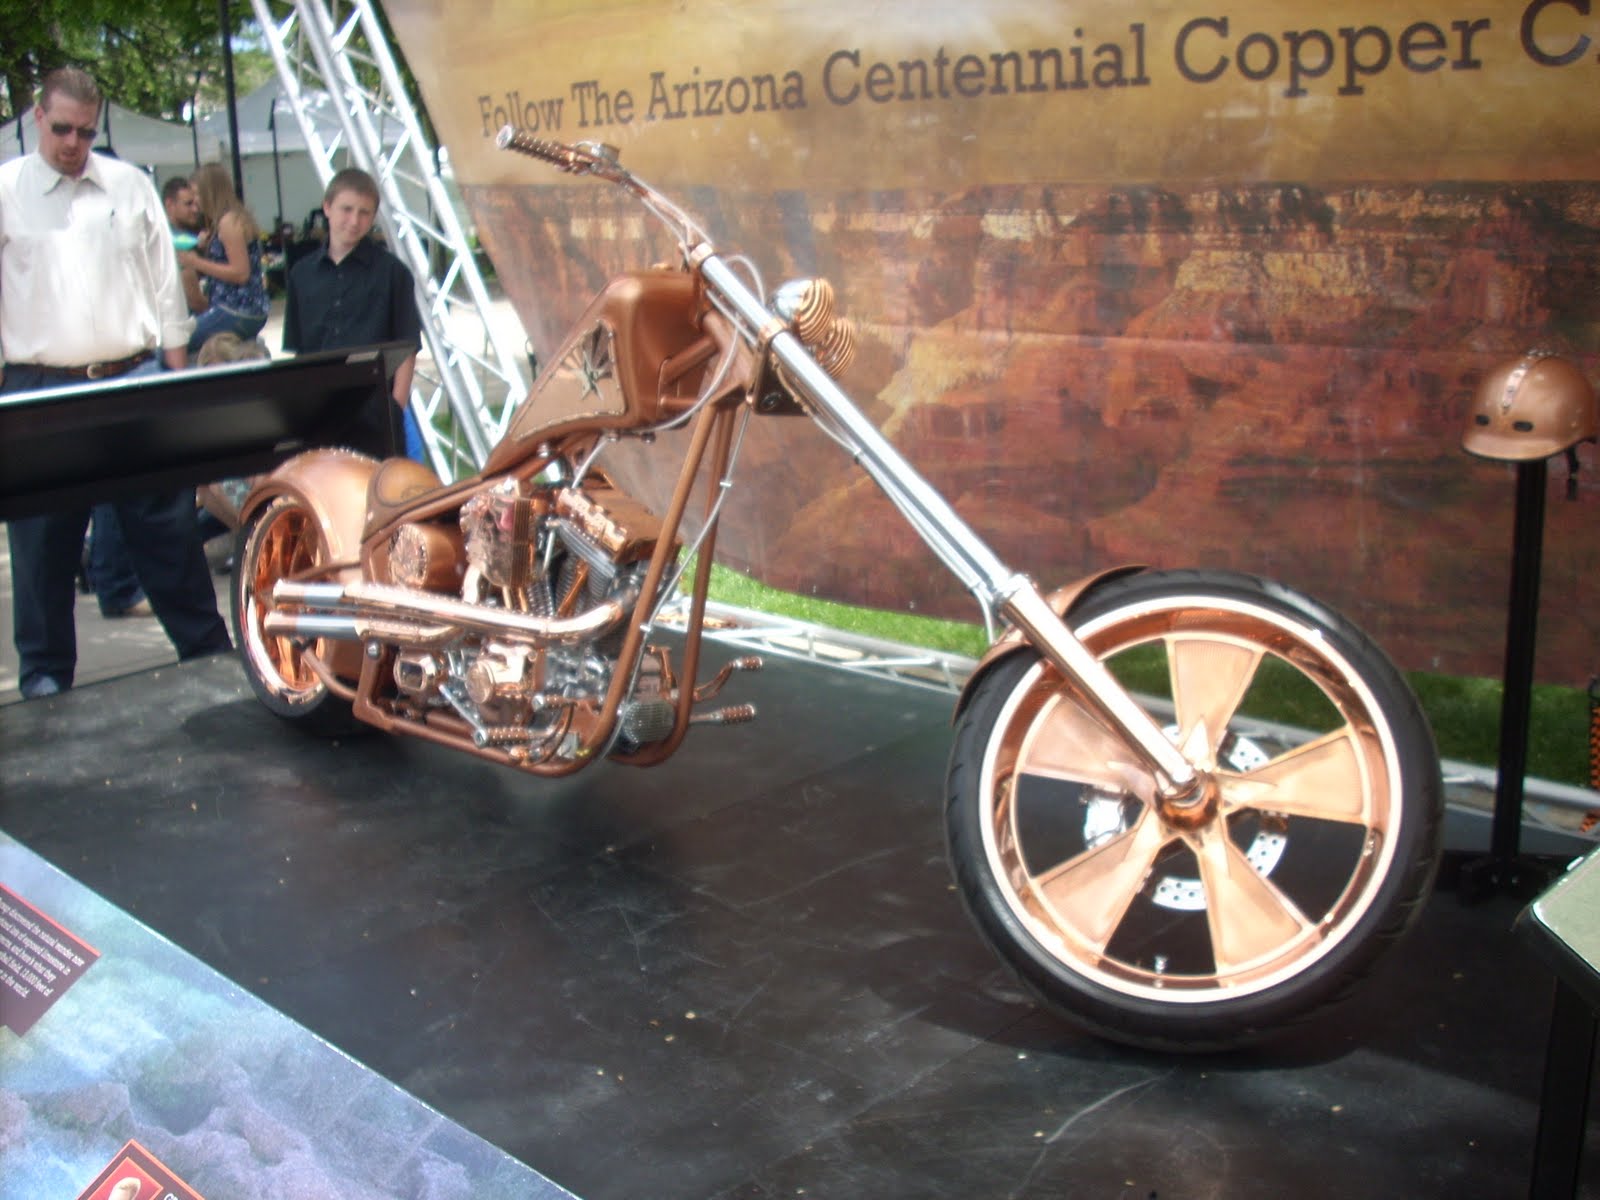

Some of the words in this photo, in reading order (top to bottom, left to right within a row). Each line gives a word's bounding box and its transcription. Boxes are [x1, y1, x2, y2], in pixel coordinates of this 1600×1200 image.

[477, 89, 565, 138] Follow
[571, 79, 635, 129] The
[645, 66, 808, 122] Arizona
[822, 22, 1151, 107] Centennial
[1174, 16, 1491, 98] Copper
[1520, 0, 1600, 67] C
